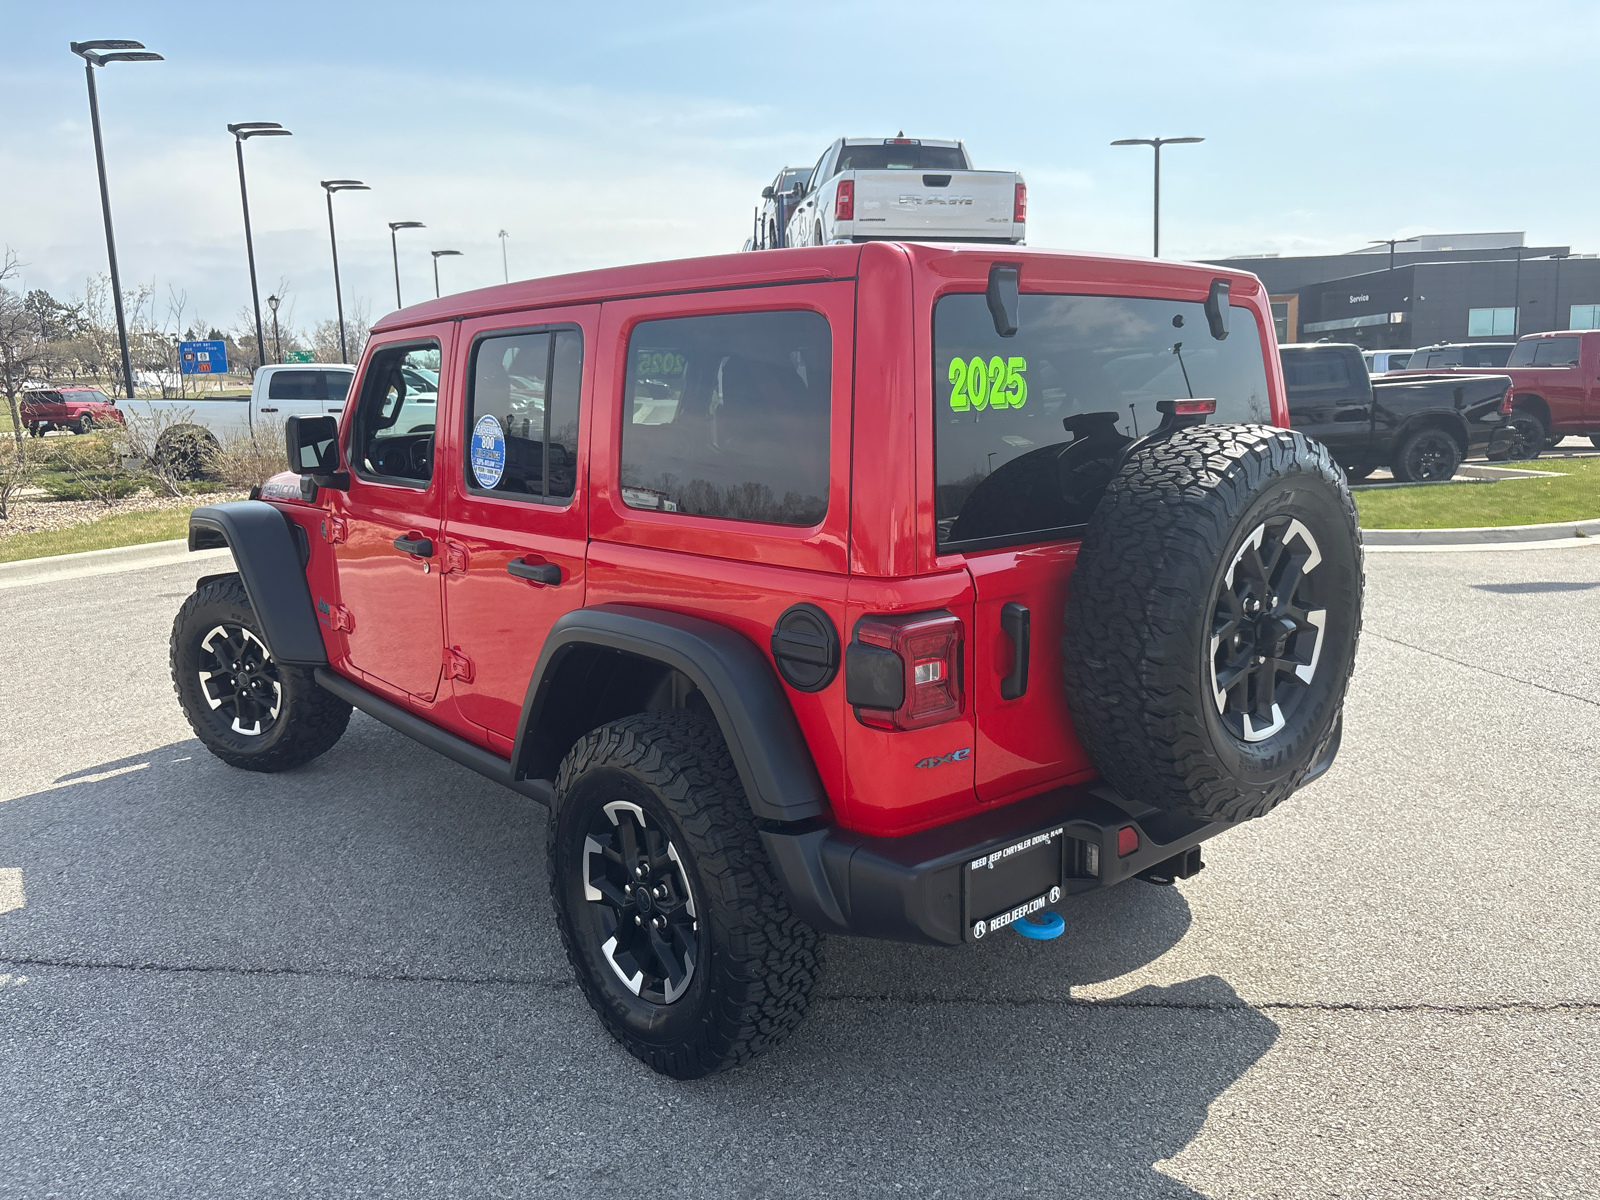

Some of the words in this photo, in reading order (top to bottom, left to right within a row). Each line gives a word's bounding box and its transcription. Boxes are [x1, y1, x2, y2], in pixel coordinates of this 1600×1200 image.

[899, 195, 973, 205] RAM
[1349, 294, 1370, 304] Service
[948, 356, 1028, 412] 2025
[914, 747, 970, 769] 4xe
[972, 857, 987, 870] REED
[989, 851, 1002, 862] JEEP
[1003, 839, 1031, 857] CHRYSLER
[990, 897, 1046, 931] REEDJEEP.COM
